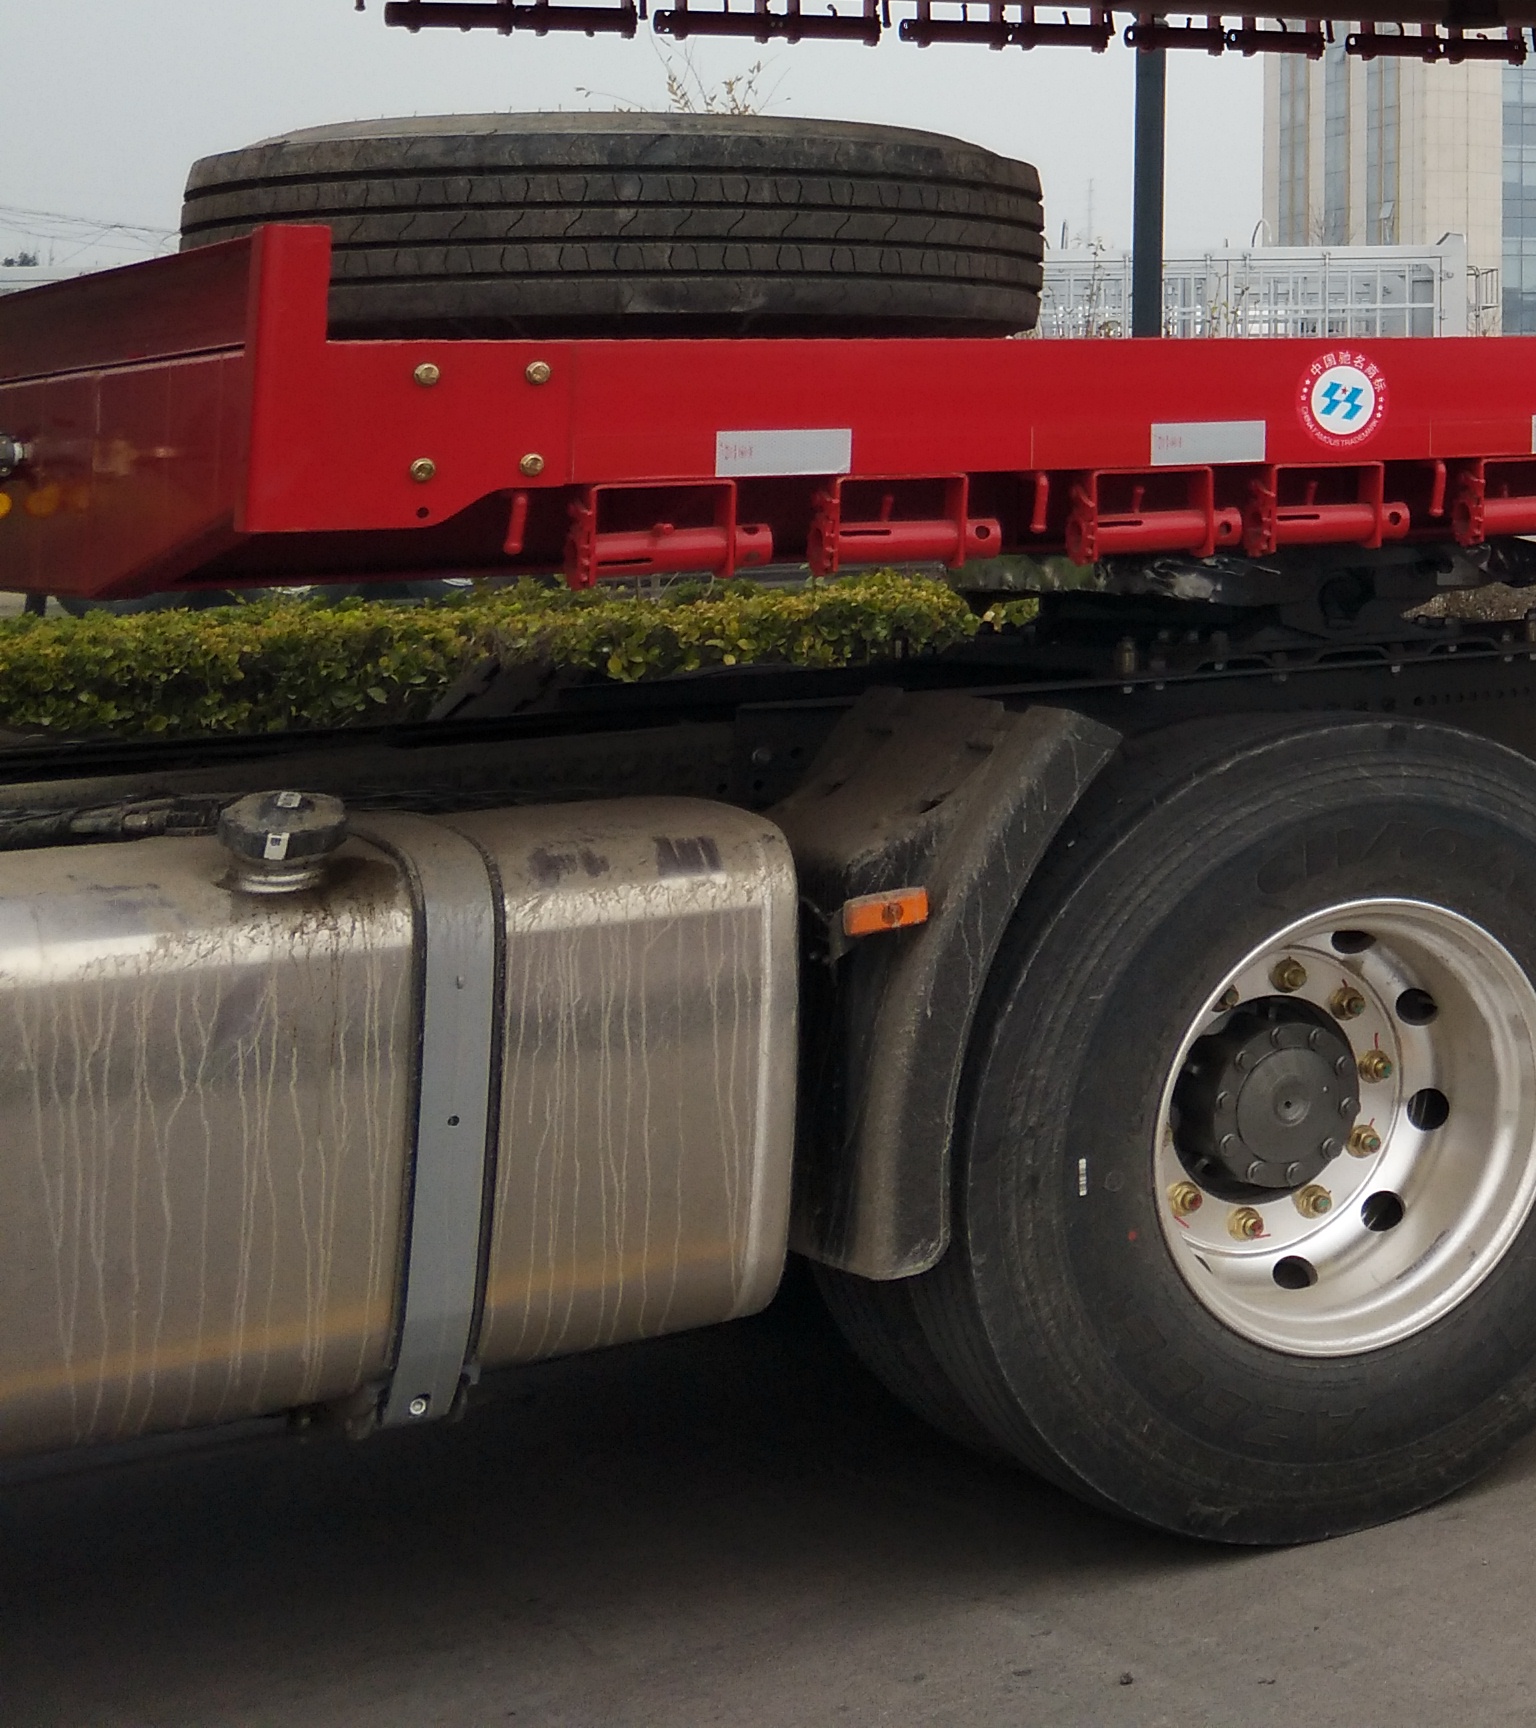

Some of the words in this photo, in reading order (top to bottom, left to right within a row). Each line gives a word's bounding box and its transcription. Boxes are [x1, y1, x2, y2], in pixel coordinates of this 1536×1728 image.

[1310, 351, 1386, 393] 中国驰名商标
